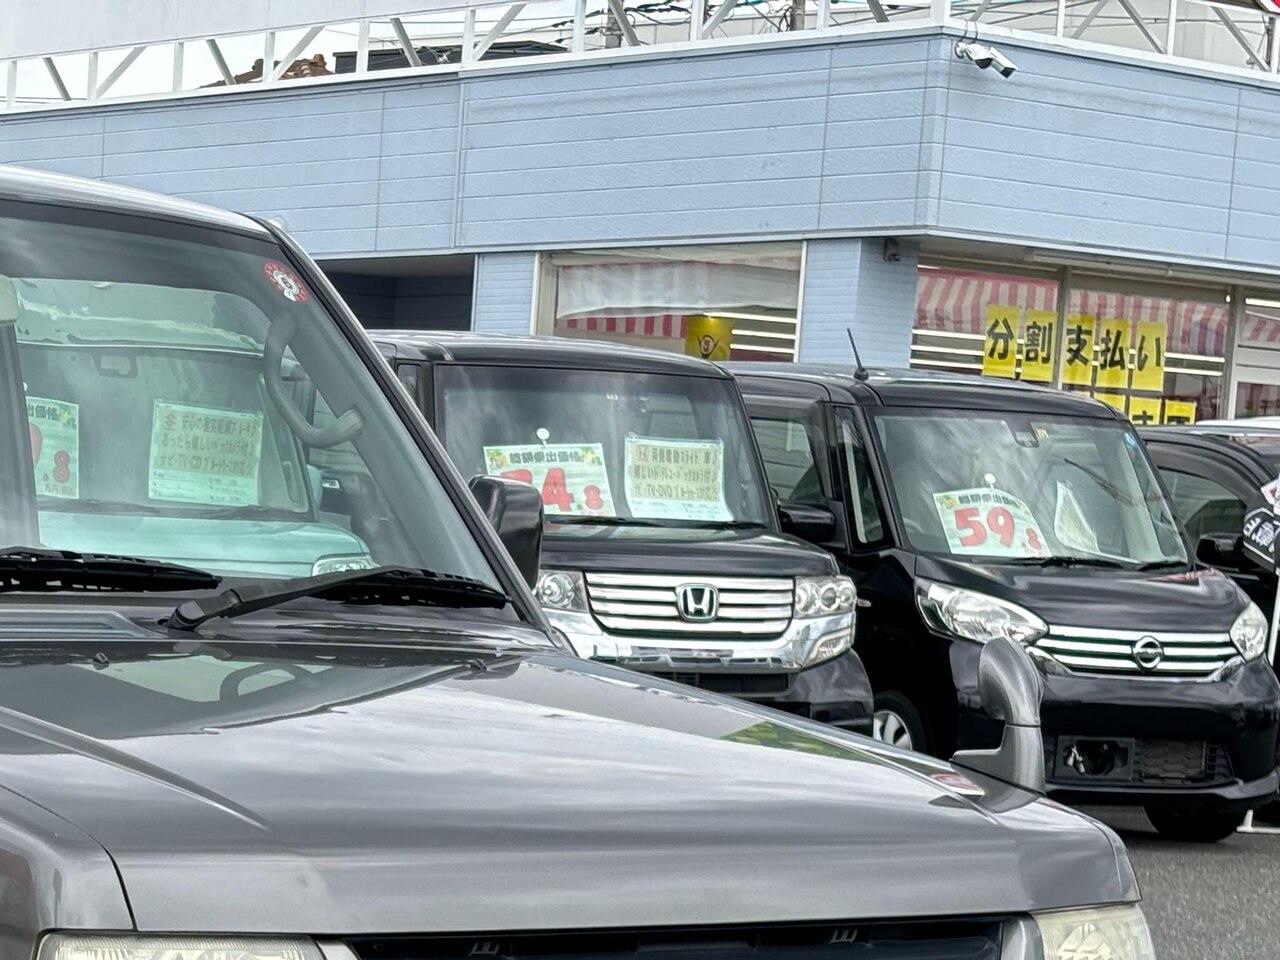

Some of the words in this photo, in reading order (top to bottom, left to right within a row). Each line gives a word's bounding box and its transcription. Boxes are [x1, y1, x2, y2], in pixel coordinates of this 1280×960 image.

[986, 318, 1162, 372] 分割支払い
